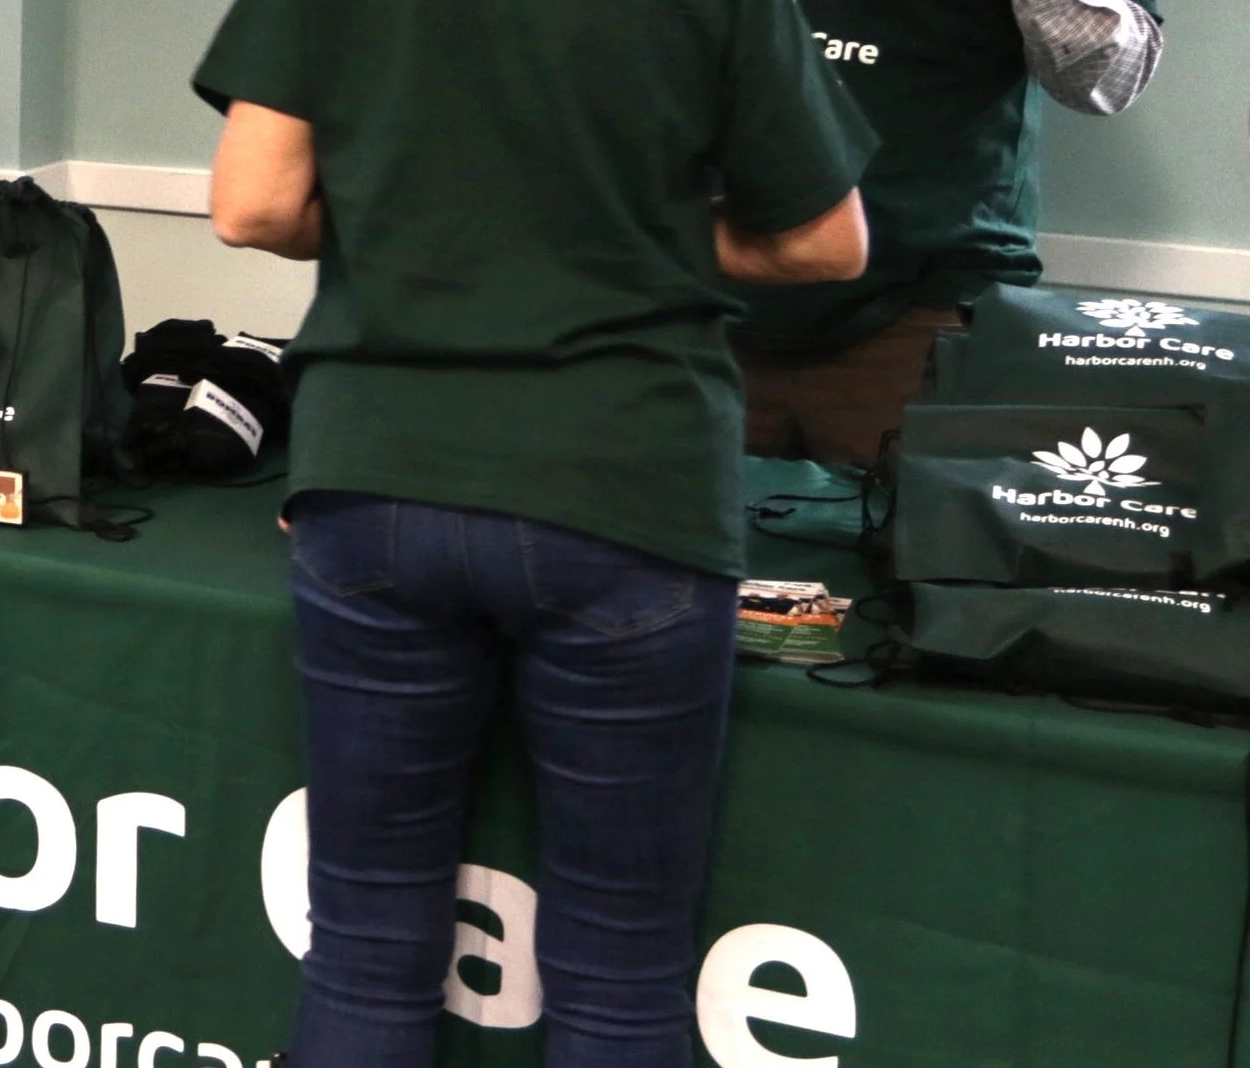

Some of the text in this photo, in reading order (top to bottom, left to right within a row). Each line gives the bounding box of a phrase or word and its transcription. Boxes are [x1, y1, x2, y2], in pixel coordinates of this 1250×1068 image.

[1038, 333, 1235, 361] Harbor Care
[1065, 355, 1206, 370] harborcarenh.org
[992, 485, 1197, 520] Harbor Care
[1019, 511, 1170, 538] harborcarenh.org
[261, 787, 857, 1068] ae
